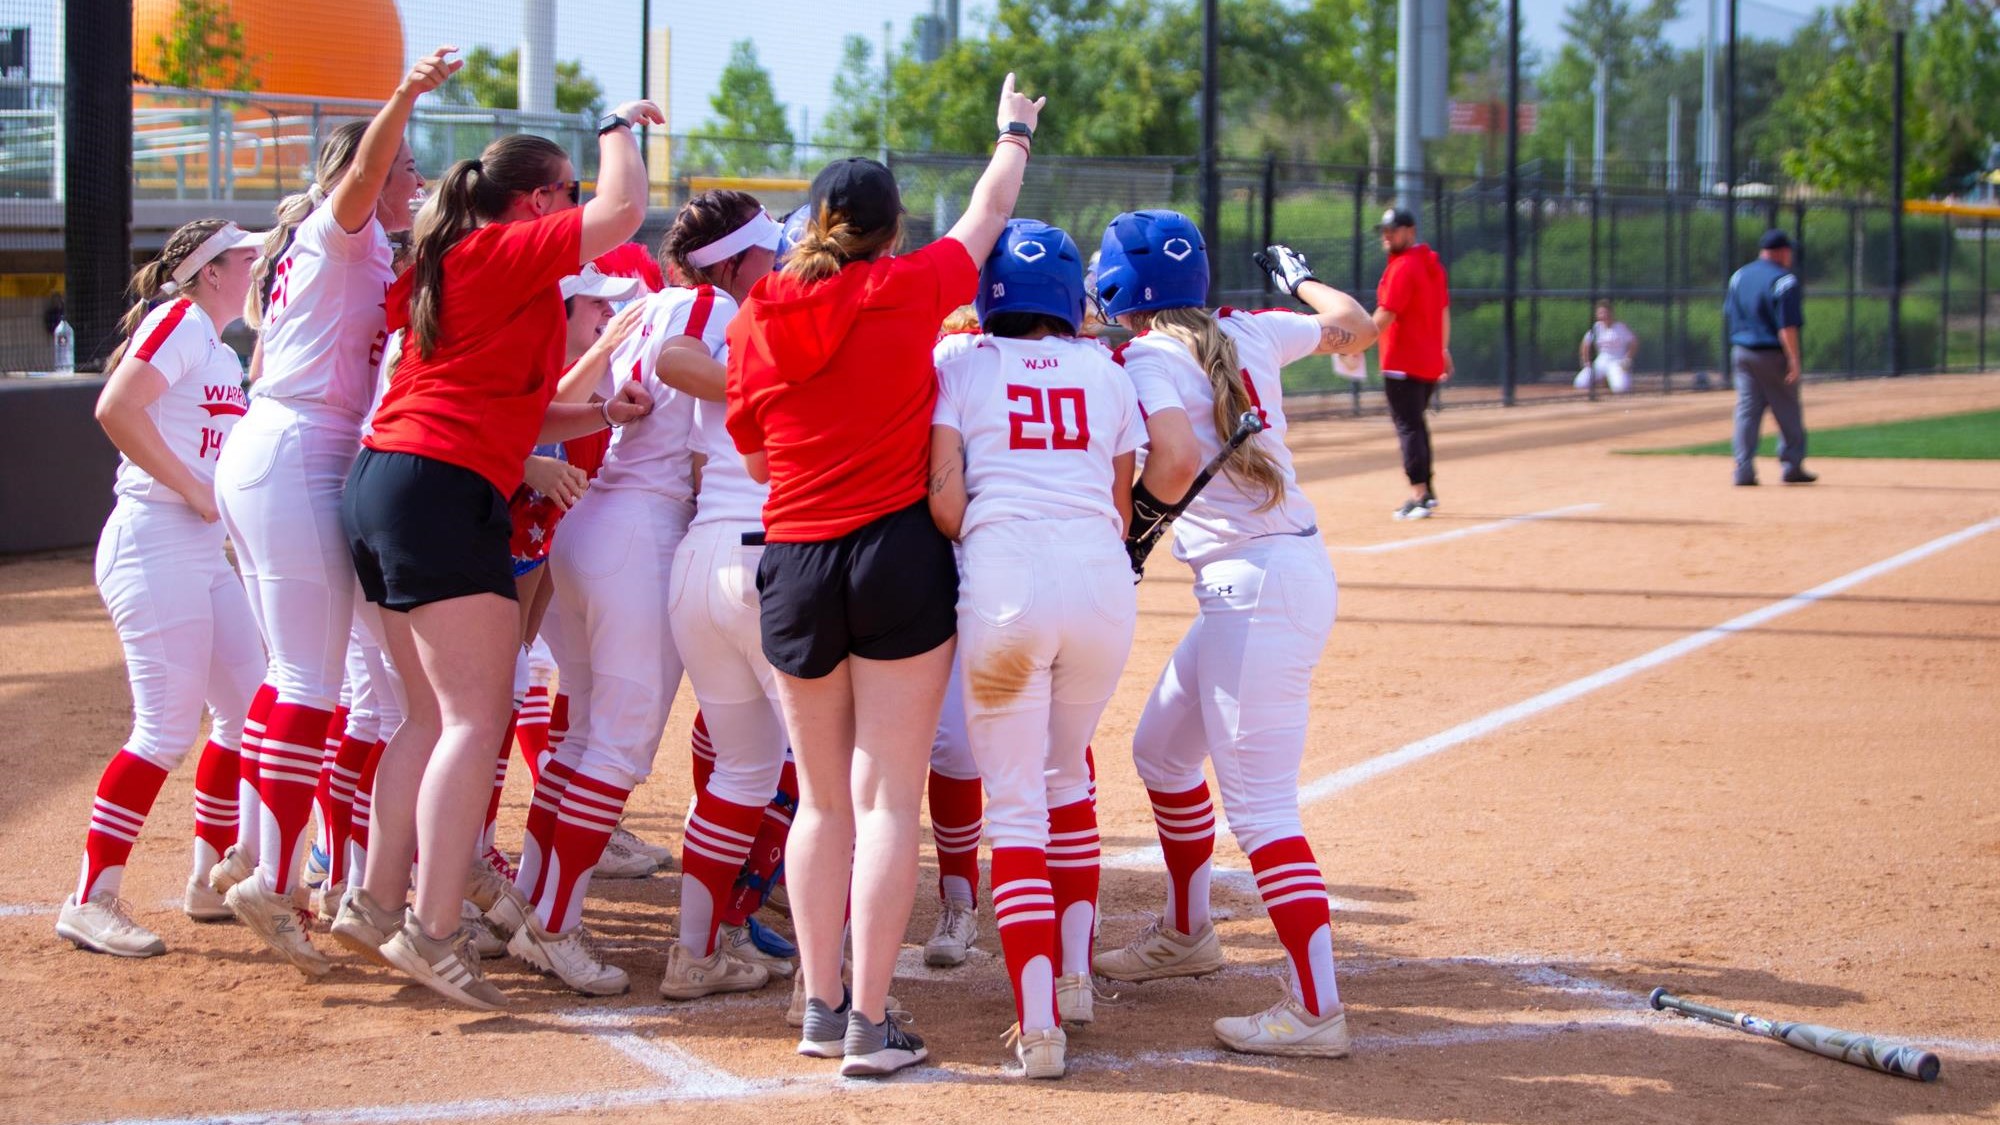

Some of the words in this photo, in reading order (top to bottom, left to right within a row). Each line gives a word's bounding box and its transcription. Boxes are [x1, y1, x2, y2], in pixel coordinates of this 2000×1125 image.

[992, 282, 1005, 298] 20
[1144, 287, 1152, 300] 8
[1022, 358, 1059, 370] WJU
[1007, 383, 1090, 452] 20
[199, 427, 223, 461] 14
